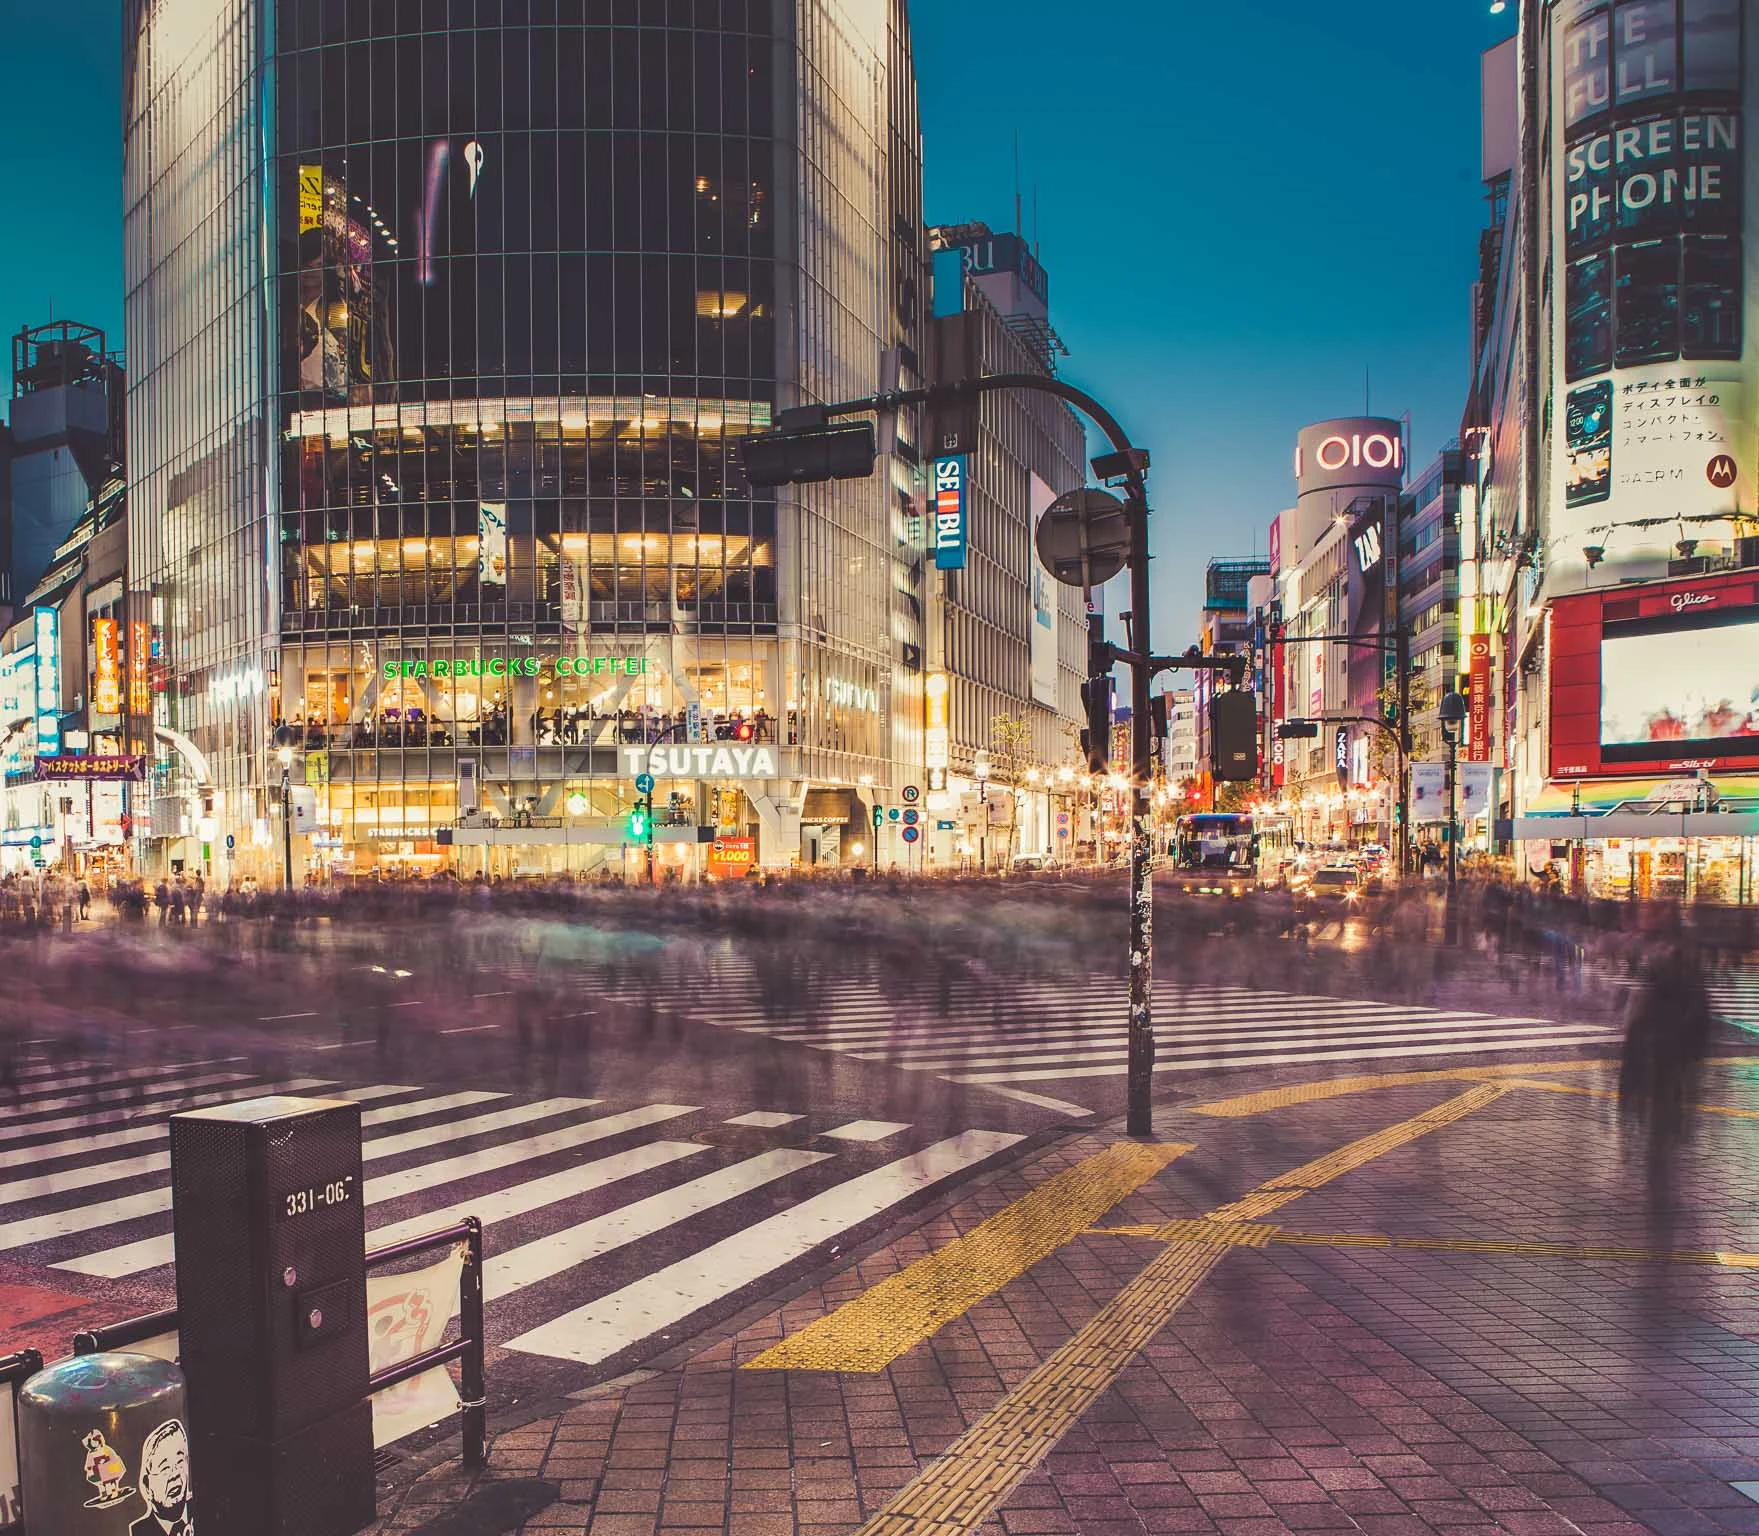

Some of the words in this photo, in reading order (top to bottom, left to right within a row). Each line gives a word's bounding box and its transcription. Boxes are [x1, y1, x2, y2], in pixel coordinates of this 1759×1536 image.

[1567, 5, 1646, 68] THE
[1568, 54, 1669, 120] FULL
[1568, 115, 1736, 183] SCREEN
[1570, 165, 1721, 231] PHONE
[1670, 592, 1716, 611] Glico
[383, 656, 540, 679] STARBUCKS
[623, 748, 775, 775] TSUTAYA
[1337, 732, 1346, 768] ZARA
